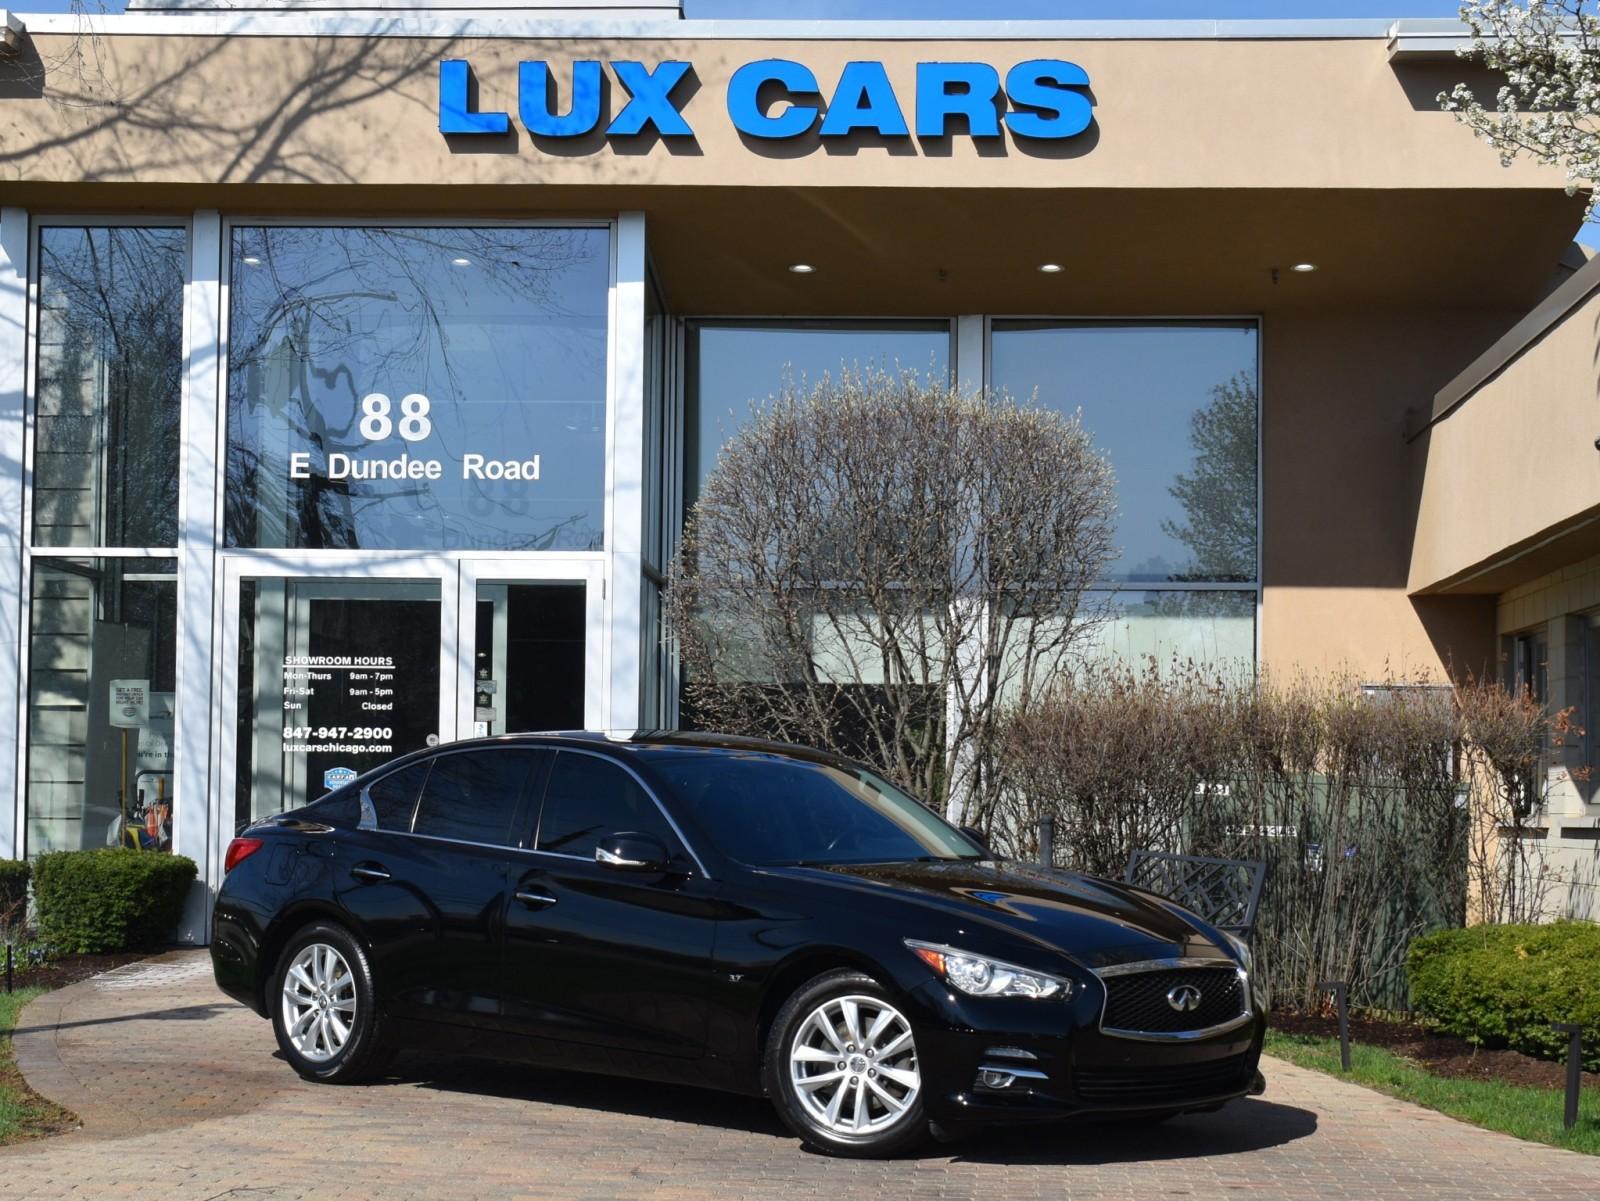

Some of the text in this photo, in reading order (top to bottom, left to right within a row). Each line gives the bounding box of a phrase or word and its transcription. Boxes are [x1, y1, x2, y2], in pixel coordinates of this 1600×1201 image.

[439, 59, 1094, 140] LUX CARS
[359, 392, 432, 442] 88
[290, 453, 541, 481] E Dundee Road
[285, 655, 393, 666] SHOWROOM HOURS
[283, 671, 332, 681] Mon-Thurs
[349, 672, 368, 681] 9am
[375, 672, 394, 682] 7pm
[283, 687, 315, 696] Fri-Sat
[349, 688, 368, 697] 9am
[375, 688, 394, 698] 5pm
[283, 701, 393, 711] Sun Closed
[283, 727, 393, 740] 847-947-2900
[282, 742, 393, 755] luxcarschicago.com
